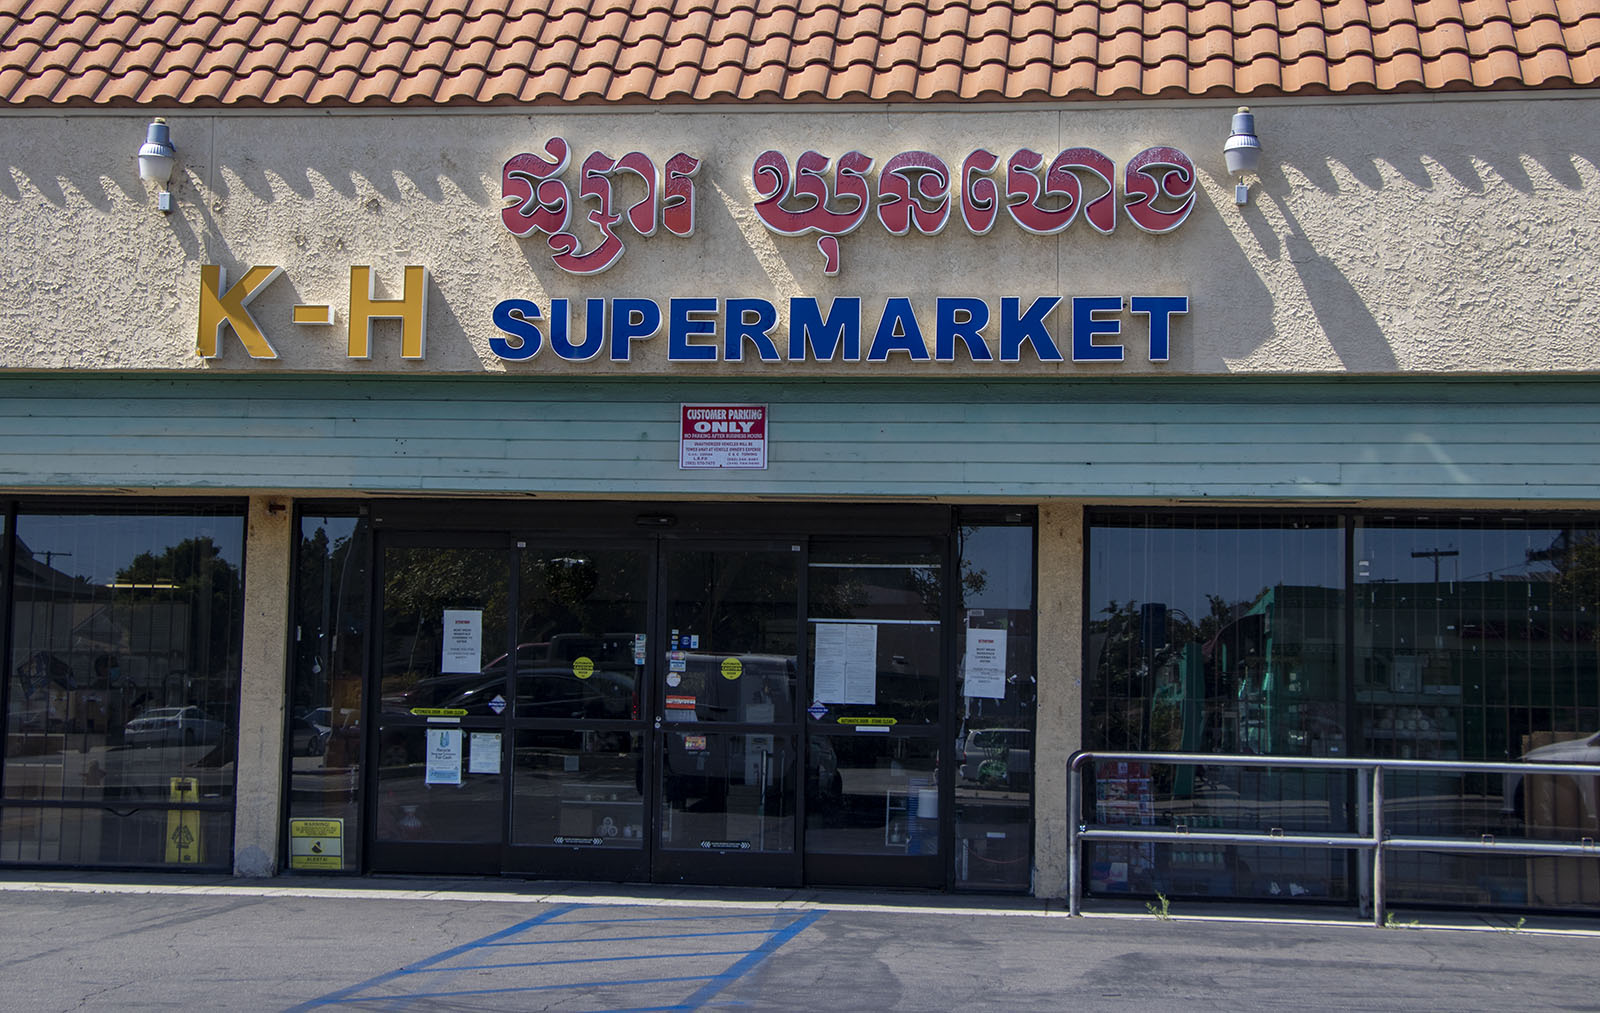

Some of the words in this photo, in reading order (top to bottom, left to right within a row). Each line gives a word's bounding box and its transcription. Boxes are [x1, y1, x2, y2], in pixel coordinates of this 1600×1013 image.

[501, 136, 703, 276] ផ្សារ
[488, 296, 1191, 364] SUPERMARKET
[687, 409, 727, 420] CUSTOMER
[728, 409, 763, 420] PARKING
[694, 421, 755, 433] ONLY
